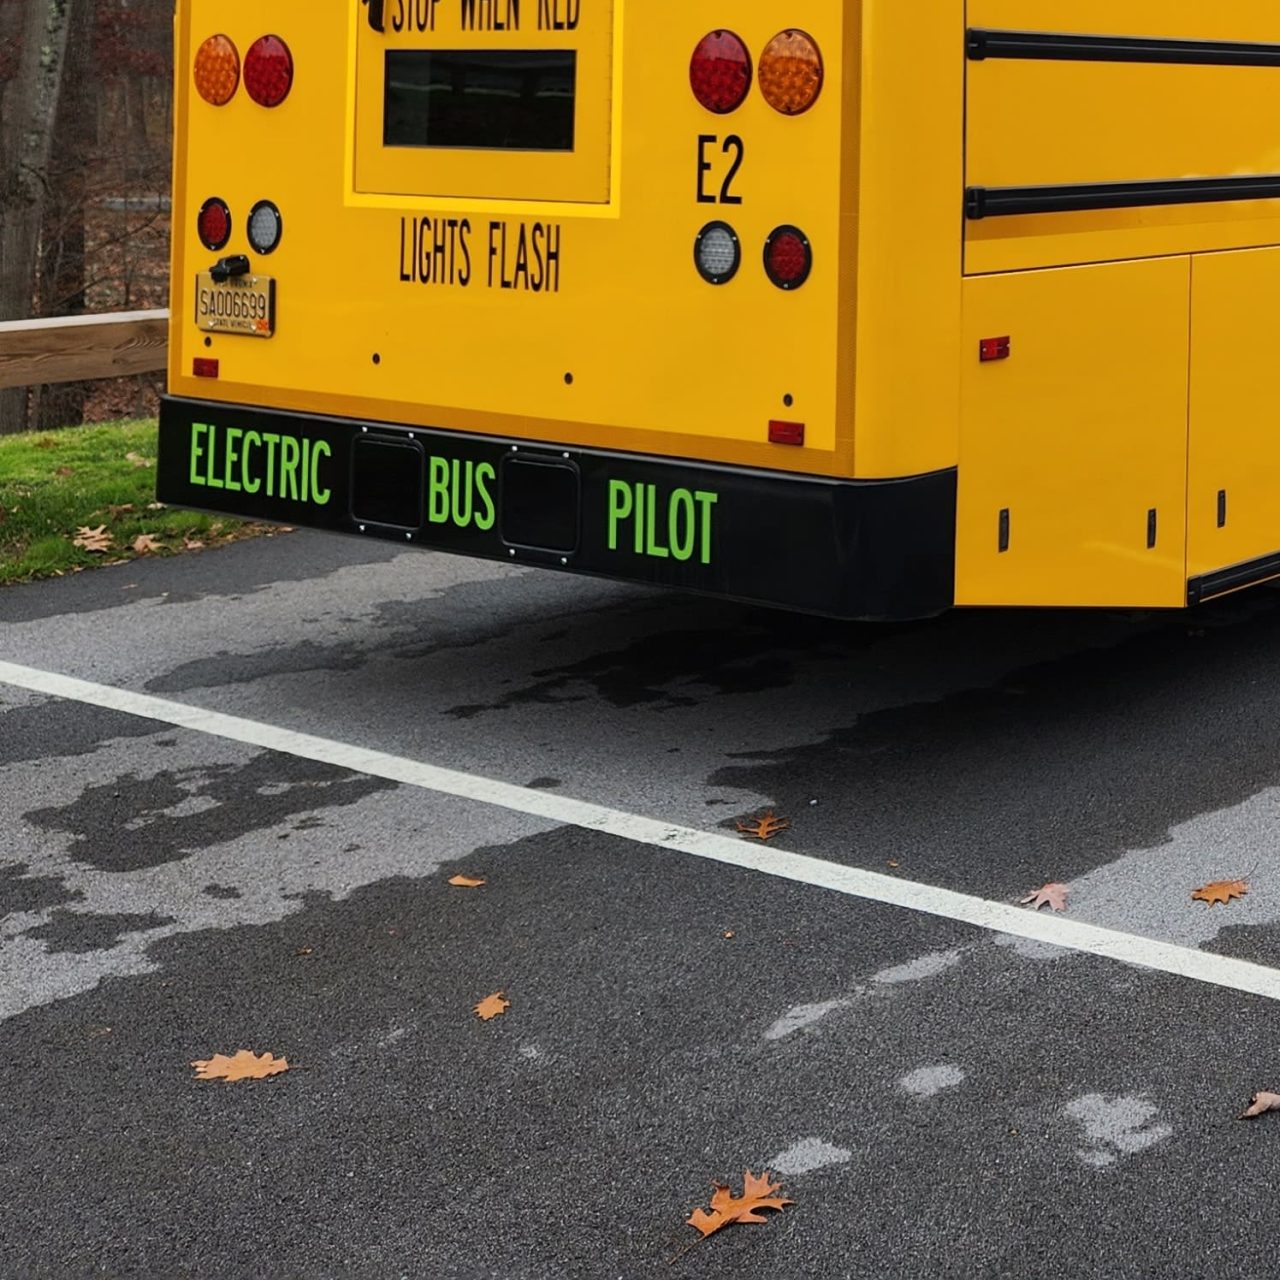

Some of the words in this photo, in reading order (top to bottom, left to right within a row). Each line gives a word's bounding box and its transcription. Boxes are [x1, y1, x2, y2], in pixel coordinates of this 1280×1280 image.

[697, 134, 744, 205] E2
[400, 216, 471, 286] LIGHTS
[487, 221, 560, 292] FLASH
[200, 289, 266, 320] SA006699
[190, 422, 331, 505] ELECTRIC
[429, 456, 496, 531] BUS
[608, 479, 718, 564] PILOT
